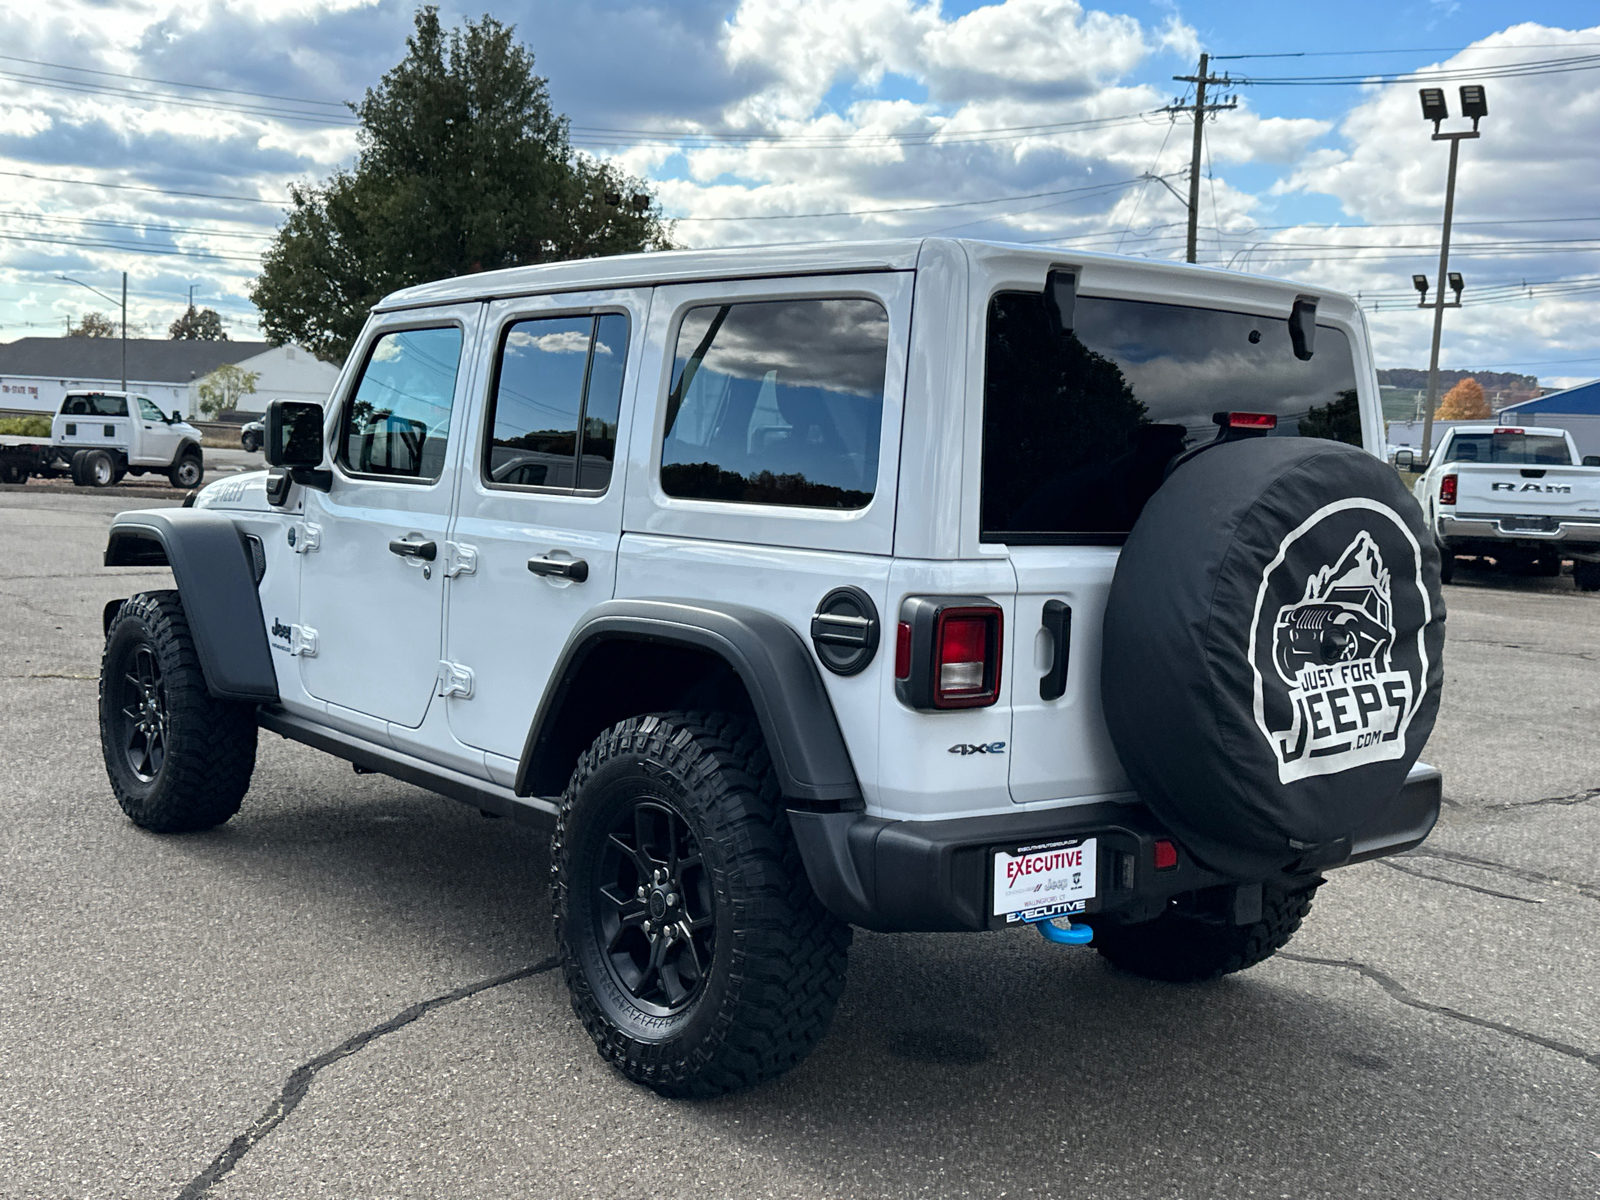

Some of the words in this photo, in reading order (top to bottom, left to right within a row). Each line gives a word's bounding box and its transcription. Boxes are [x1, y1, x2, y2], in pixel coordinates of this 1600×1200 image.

[1491, 482, 1571, 493] RAM
[1301, 668, 1335, 692] JUST
[1341, 662, 1376, 684] FOR
[1279, 680, 1407, 764] JEEPS
[1353, 730, 1382, 750] .COM
[1007, 850, 1082, 888] EXECUTIVE
[1044, 878, 1068, 891] Jeep
[1006, 900, 1086, 923] EXECUTIVE
